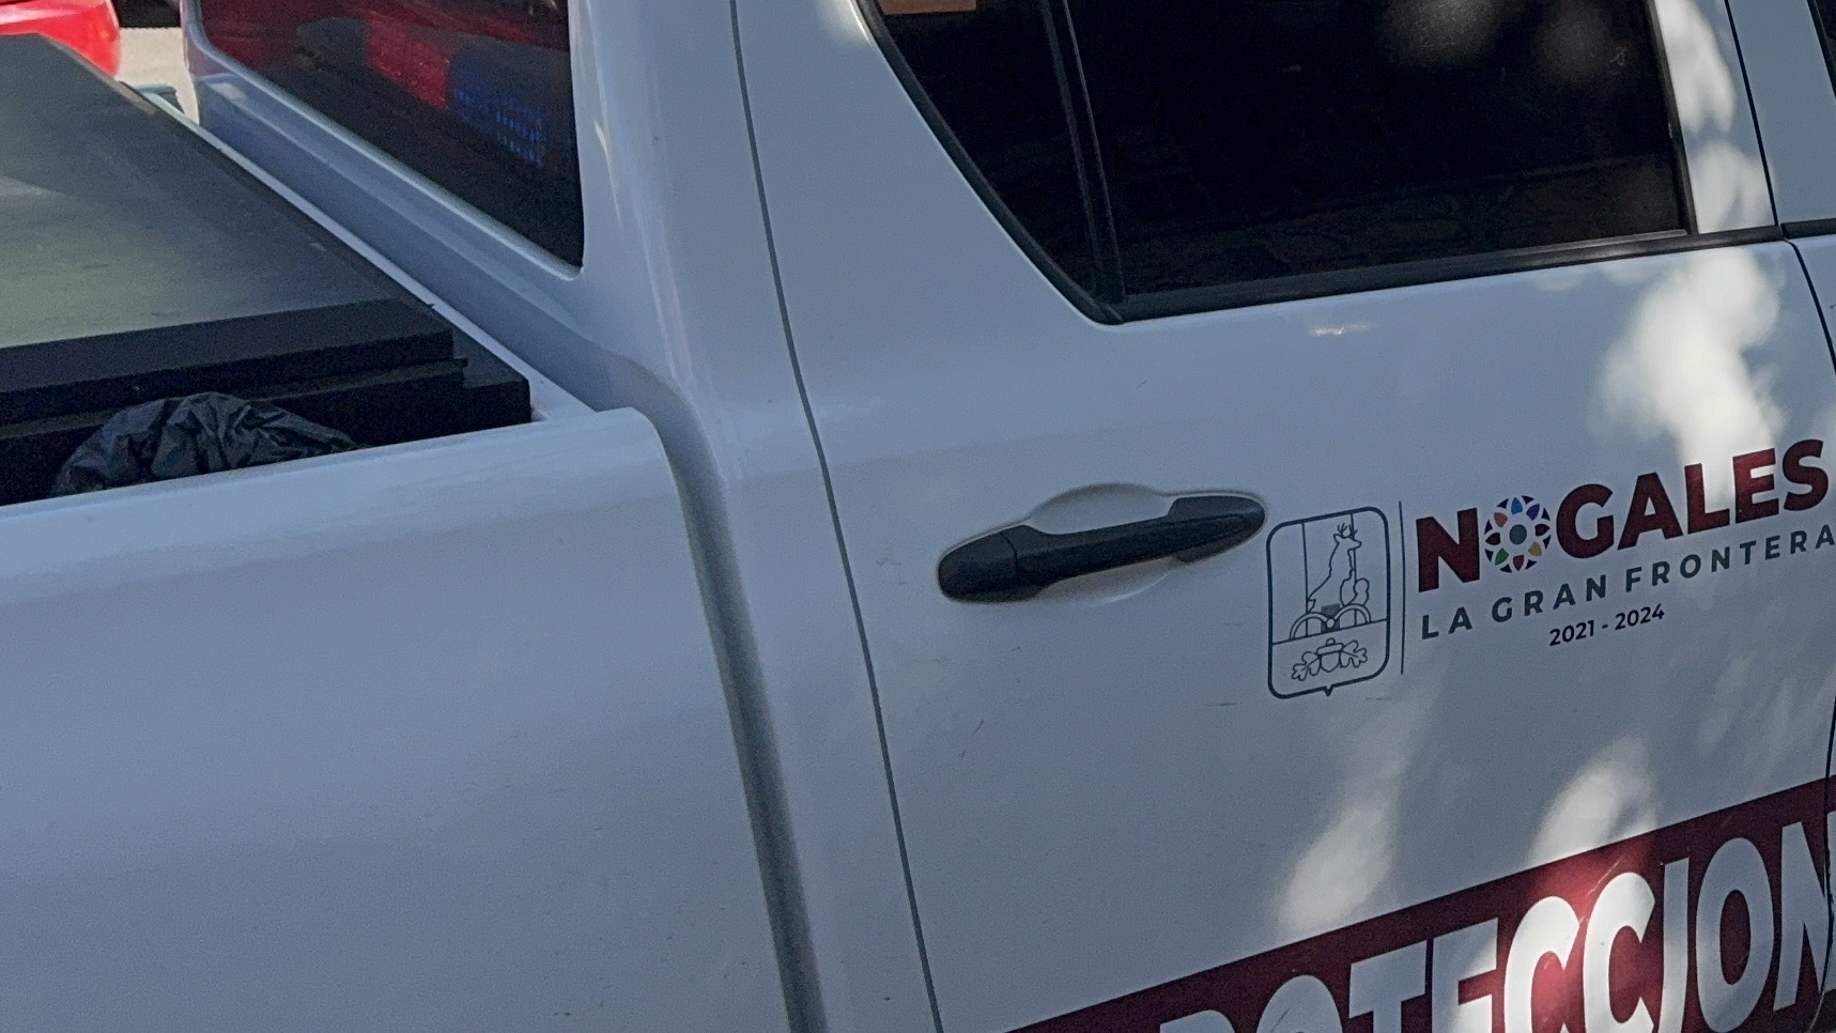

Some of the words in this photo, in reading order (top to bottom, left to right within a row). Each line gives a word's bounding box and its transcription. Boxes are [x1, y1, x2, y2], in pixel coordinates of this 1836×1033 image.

[1415, 439, 1830, 593] NOGALES
[1421, 604, 1474, 640] LA
[1491, 573, 1608, 624] GRAN
[1625, 524, 1836, 593] FRONTERA
[1549, 619, 1596, 647] 2021
[1614, 604, 1665, 631] 2024
